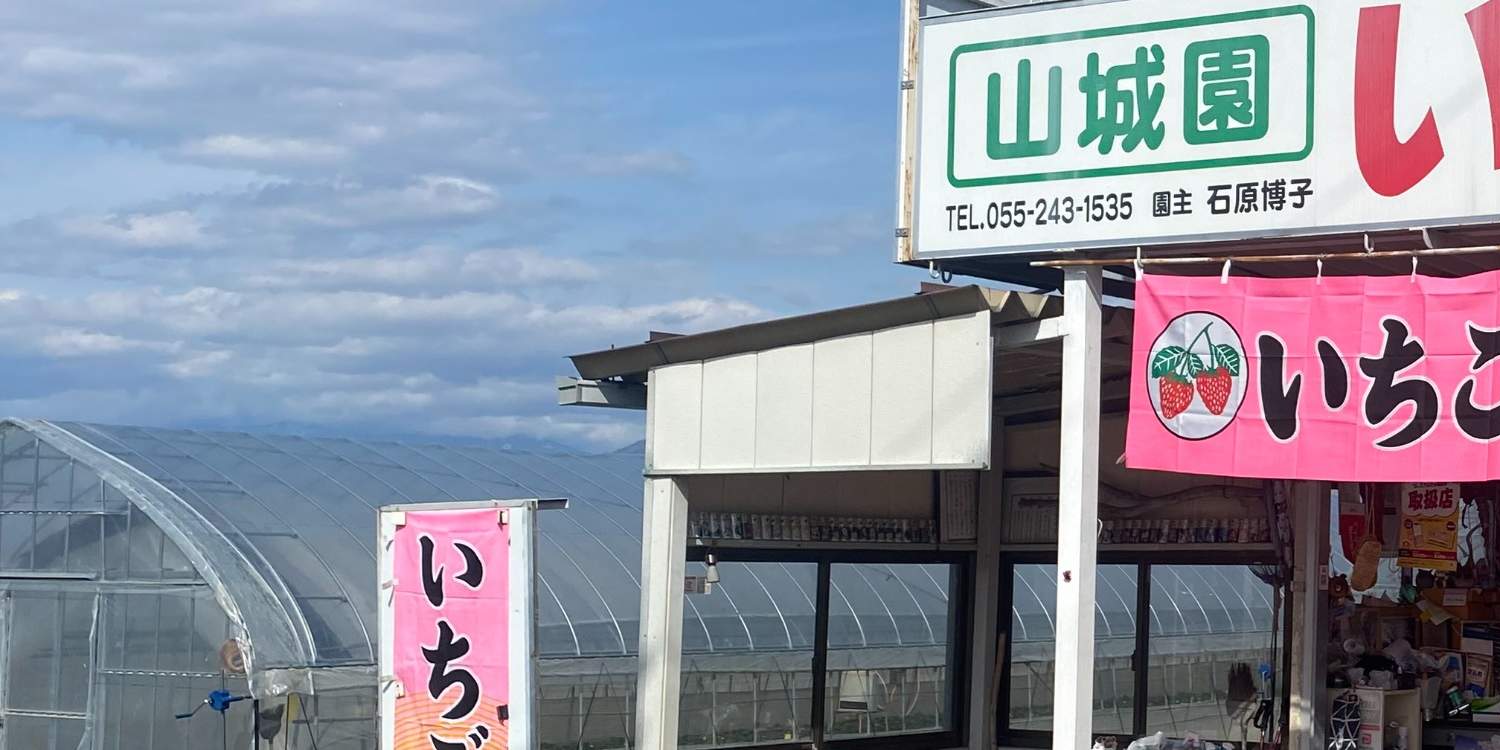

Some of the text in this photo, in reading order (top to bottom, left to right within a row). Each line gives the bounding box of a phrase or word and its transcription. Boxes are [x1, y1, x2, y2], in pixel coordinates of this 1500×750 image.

[985, 34, 1271, 160] 山城園
[946, 193, 1133, 232] TEL.055-243-1535
[1152, 178, 1314, 217] 園主 石原博子
[1408, 487, 1453, 511] 取扱店
